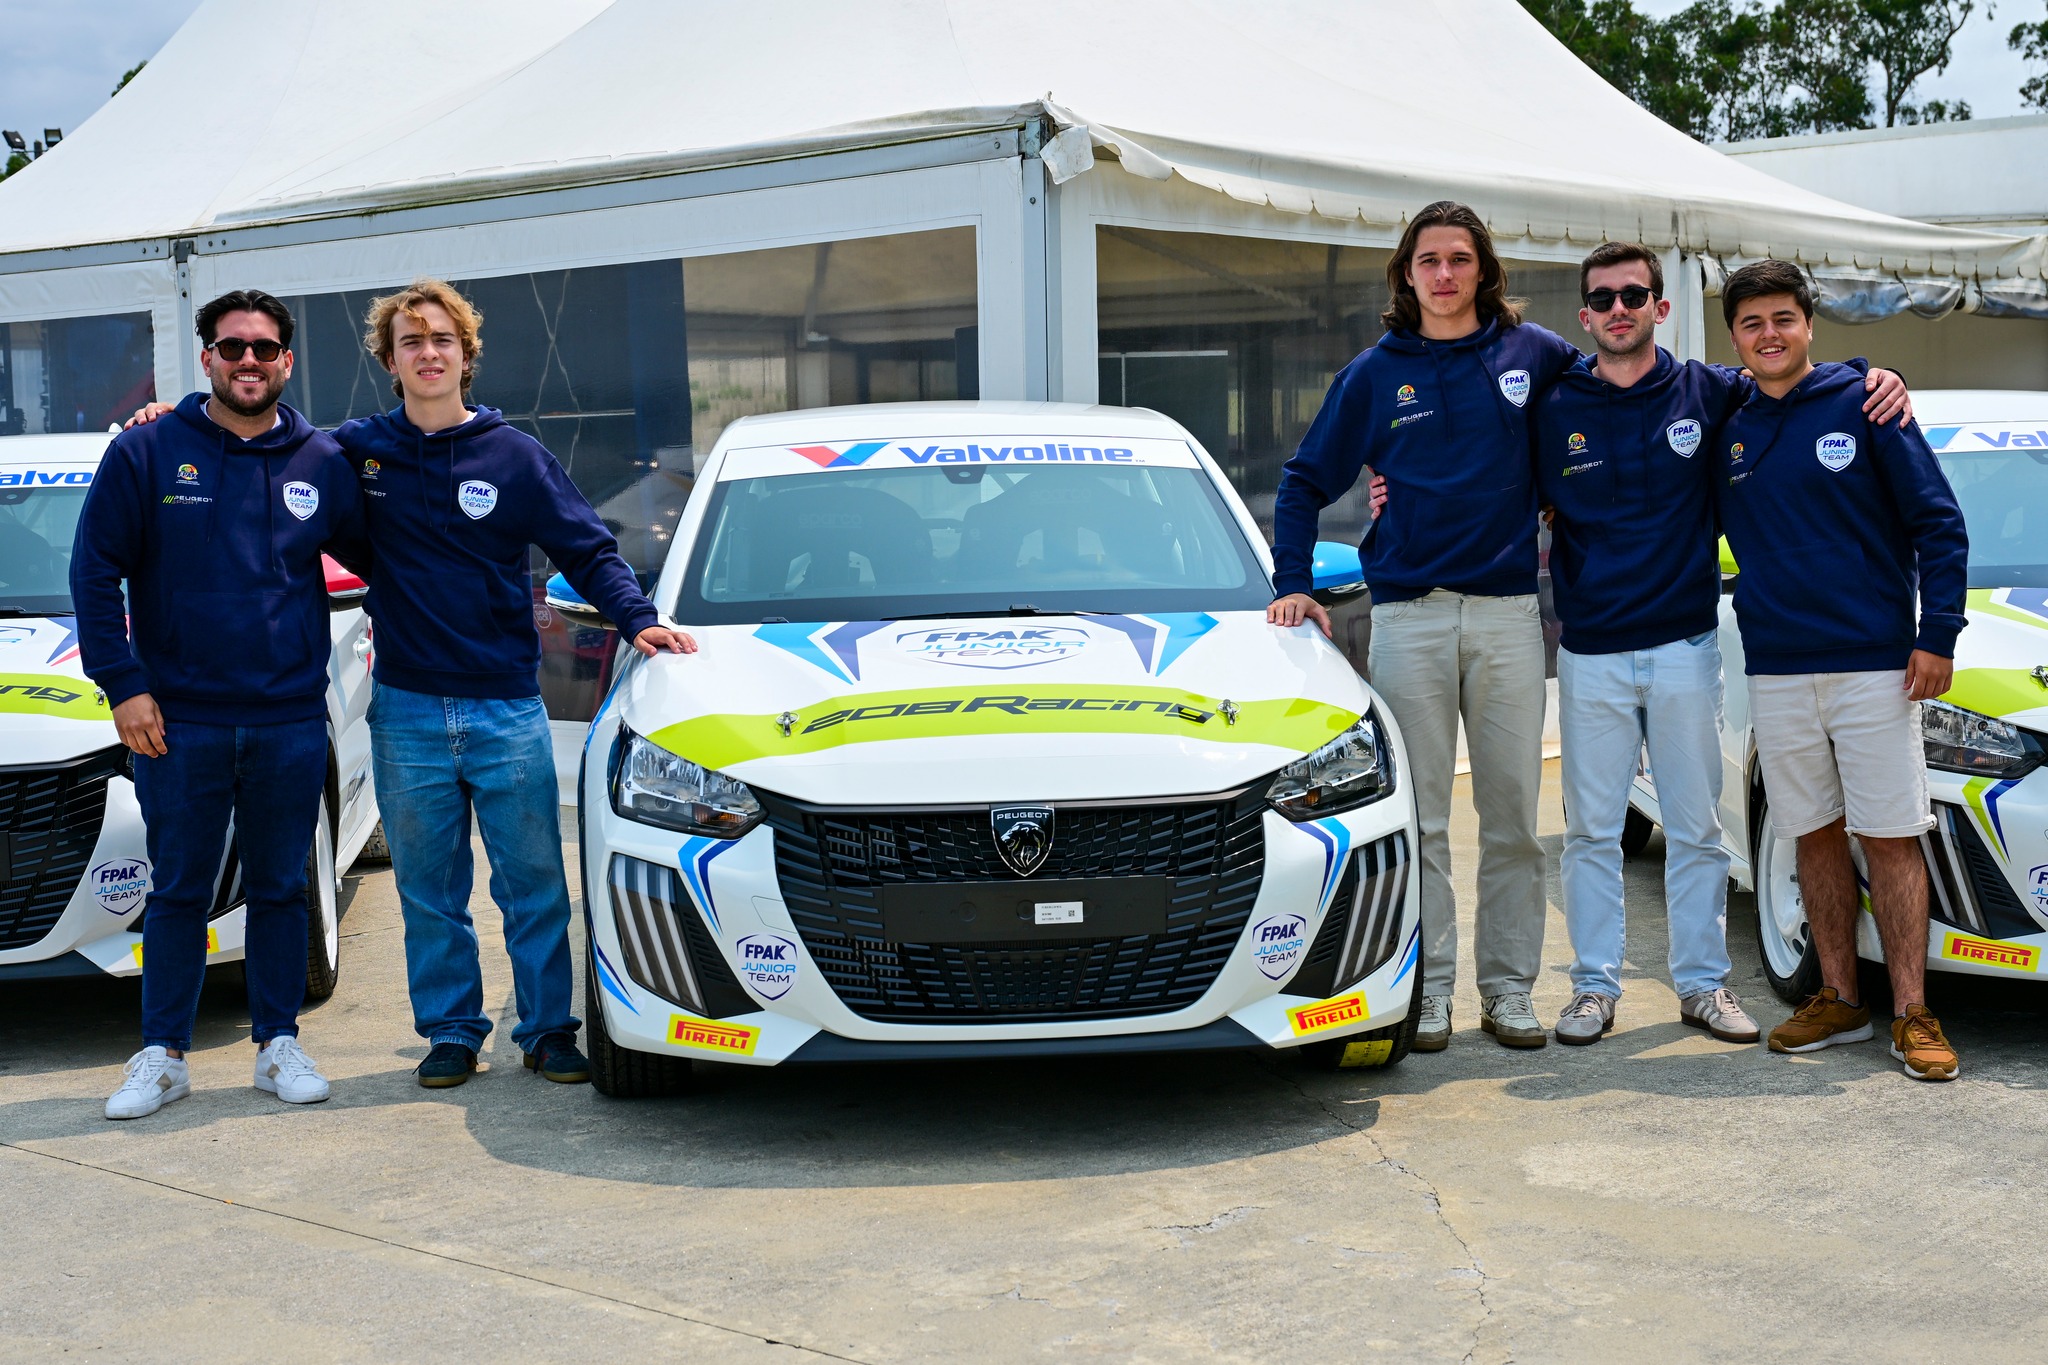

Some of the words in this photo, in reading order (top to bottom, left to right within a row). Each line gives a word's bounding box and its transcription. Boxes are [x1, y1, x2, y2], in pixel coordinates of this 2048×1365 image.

[1505, 375, 1525, 385] FPAK
[1505, 384, 1528, 392] JUNIOR
[1398, 410, 1434, 422] PEUGEOT
[1673, 424, 1694, 436] FPAK
[1672, 432, 1700, 444] JUNIOR
[1676, 439, 1698, 448] TEAM
[1823, 439, 1849, 448] FPAK
[897, 443, 1133, 463] Valvoline
[1569, 460, 1603, 470] PEUGEOT
[0, 470, 94, 486] alvo
[289, 487, 311, 497] FPAK
[465, 486, 491, 497] FPAK
[286, 497, 316, 505] JUNIOR
[291, 502, 313, 510] TEAM
[461, 496, 494, 504] JUNIOR
[464, 501, 490, 509] TEAM
[924, 630, 1060, 642] FPAK
[906, 641, 1086, 652] JUNIOR
[928, 648, 1068, 657] TEAM
[0, 685, 83, 703] ng
[801, 696, 1215, 735] 208Racing
[996, 811, 1050, 820] PEUGEOT
[100, 865, 140, 883] FPAK
[95, 880, 147, 895] JUNIOR
[102, 889, 141, 903] TEAM
[1260, 921, 1300, 942] FPAK
[745, 943, 787, 960] FPAK
[1254, 939, 1303, 956] JUNIOR
[1951, 938, 2032, 966] PIRELLI
[1260, 950, 1298, 965] TEAM
[741, 962, 796, 973] JUNIOR
[748, 972, 790, 983] TEAM
[1295, 998, 1362, 1030] PIRELLI
[675, 1020, 751, 1050] PIRELLI
